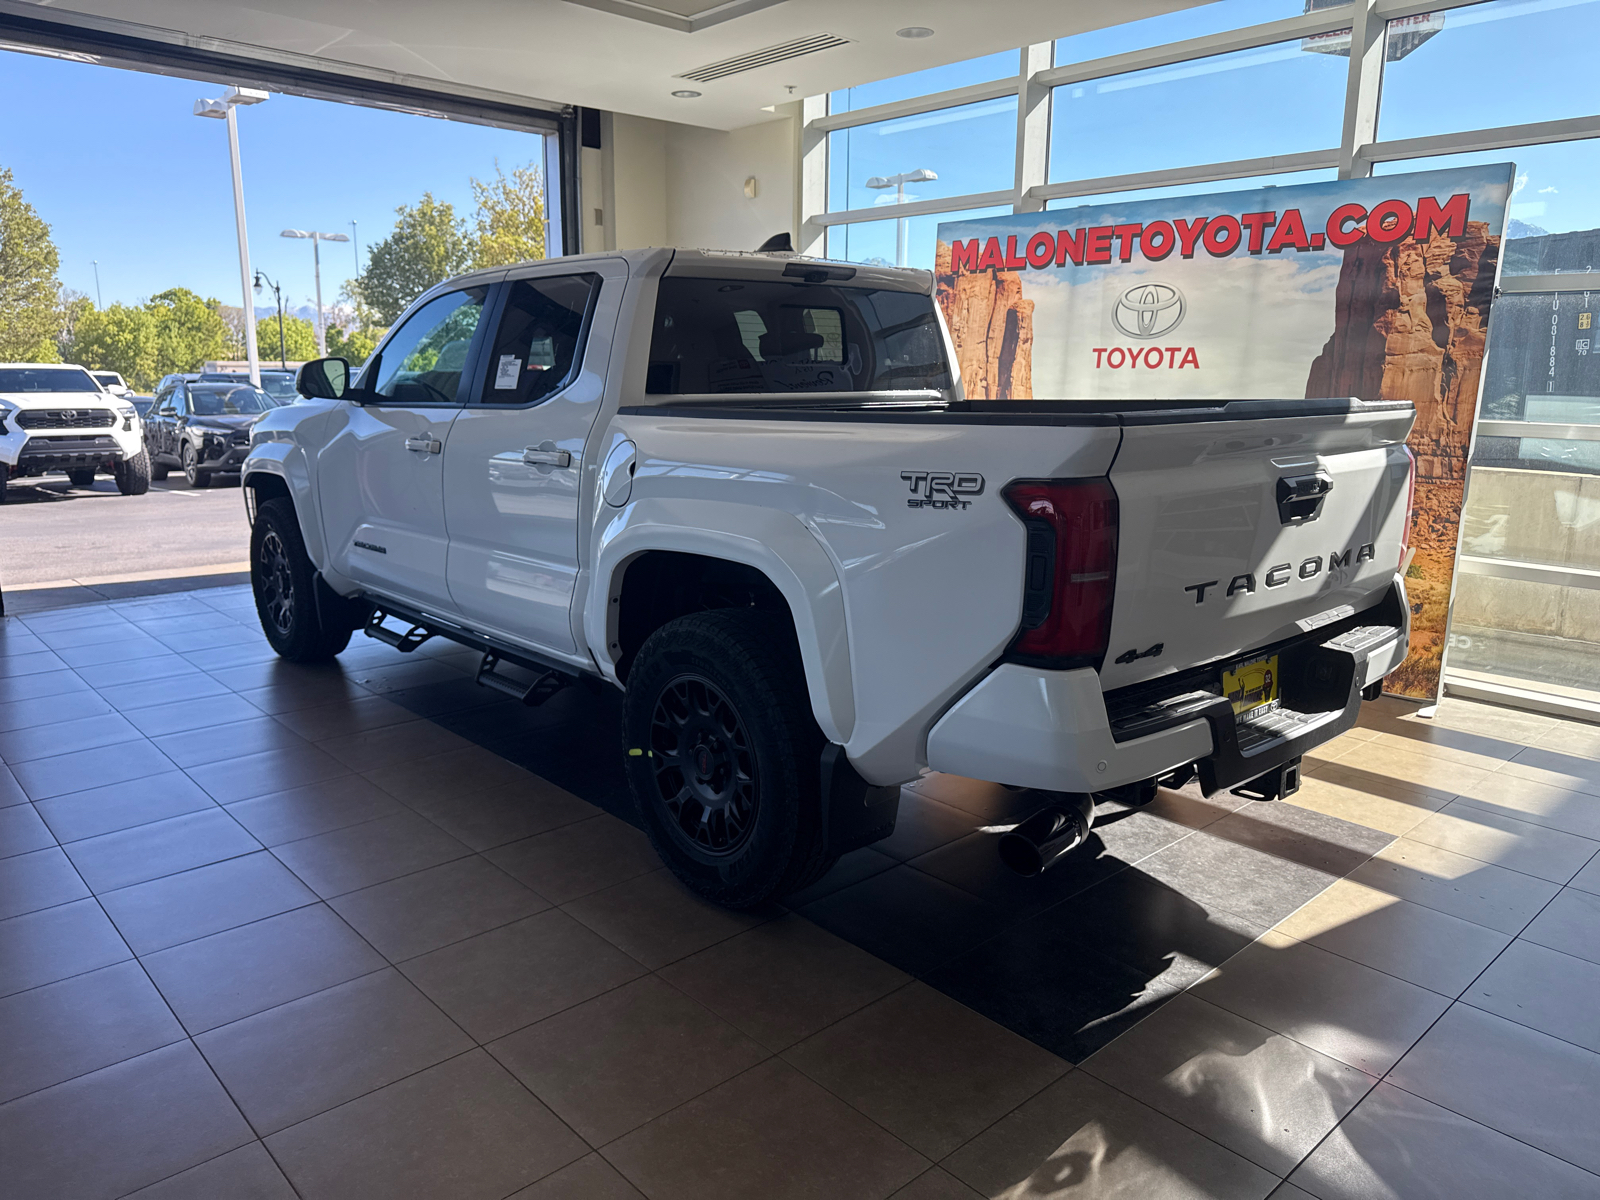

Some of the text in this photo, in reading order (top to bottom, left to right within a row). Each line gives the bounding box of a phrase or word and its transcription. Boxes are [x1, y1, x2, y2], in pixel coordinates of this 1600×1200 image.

[951, 193, 1471, 274] MALONETOYOTA.COM
[1092, 346, 1200, 369] TOYOTA
[900, 471, 986, 499] TRD
[907, 499, 972, 510] SPORT
[1184, 542, 1376, 605] TACOMA
